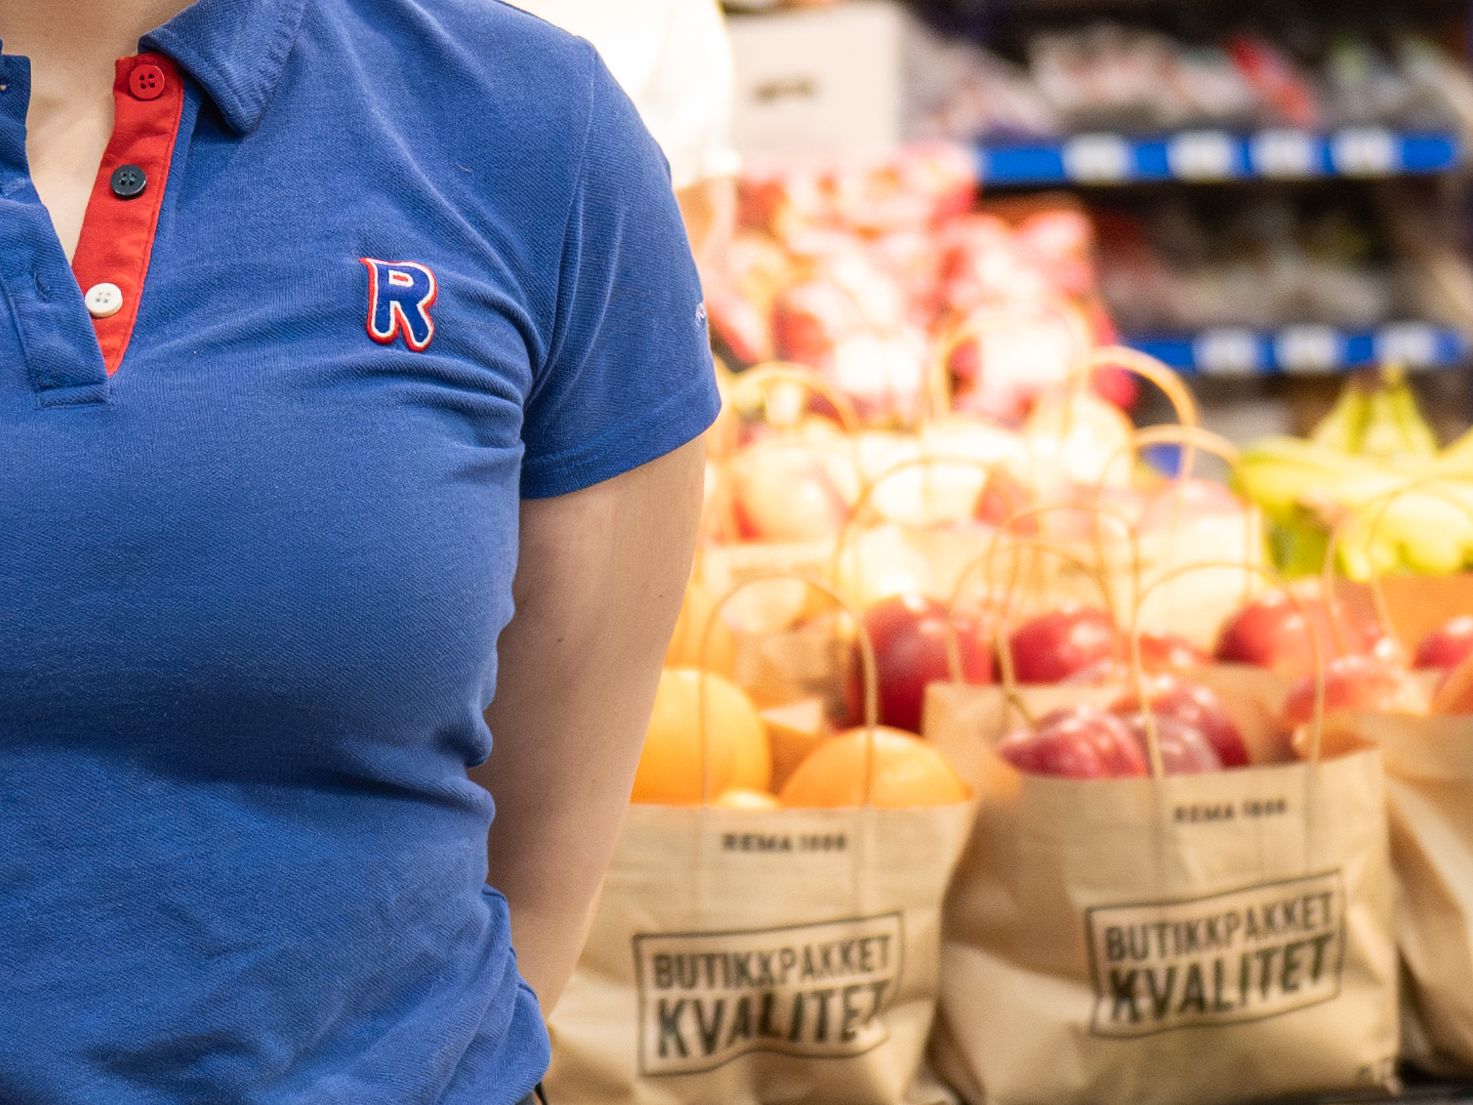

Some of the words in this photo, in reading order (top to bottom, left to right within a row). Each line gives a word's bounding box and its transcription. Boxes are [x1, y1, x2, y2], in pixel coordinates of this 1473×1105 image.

[358, 257, 438, 353] R
[721, 832, 791, 853] REMA
[652, 934, 893, 991] BUTIKKPAKKET
[1104, 892, 1335, 964] BUTIKKPAKKET
[1108, 933, 1334, 1025] KVALITET
[656, 981, 891, 1060] KVALITET
